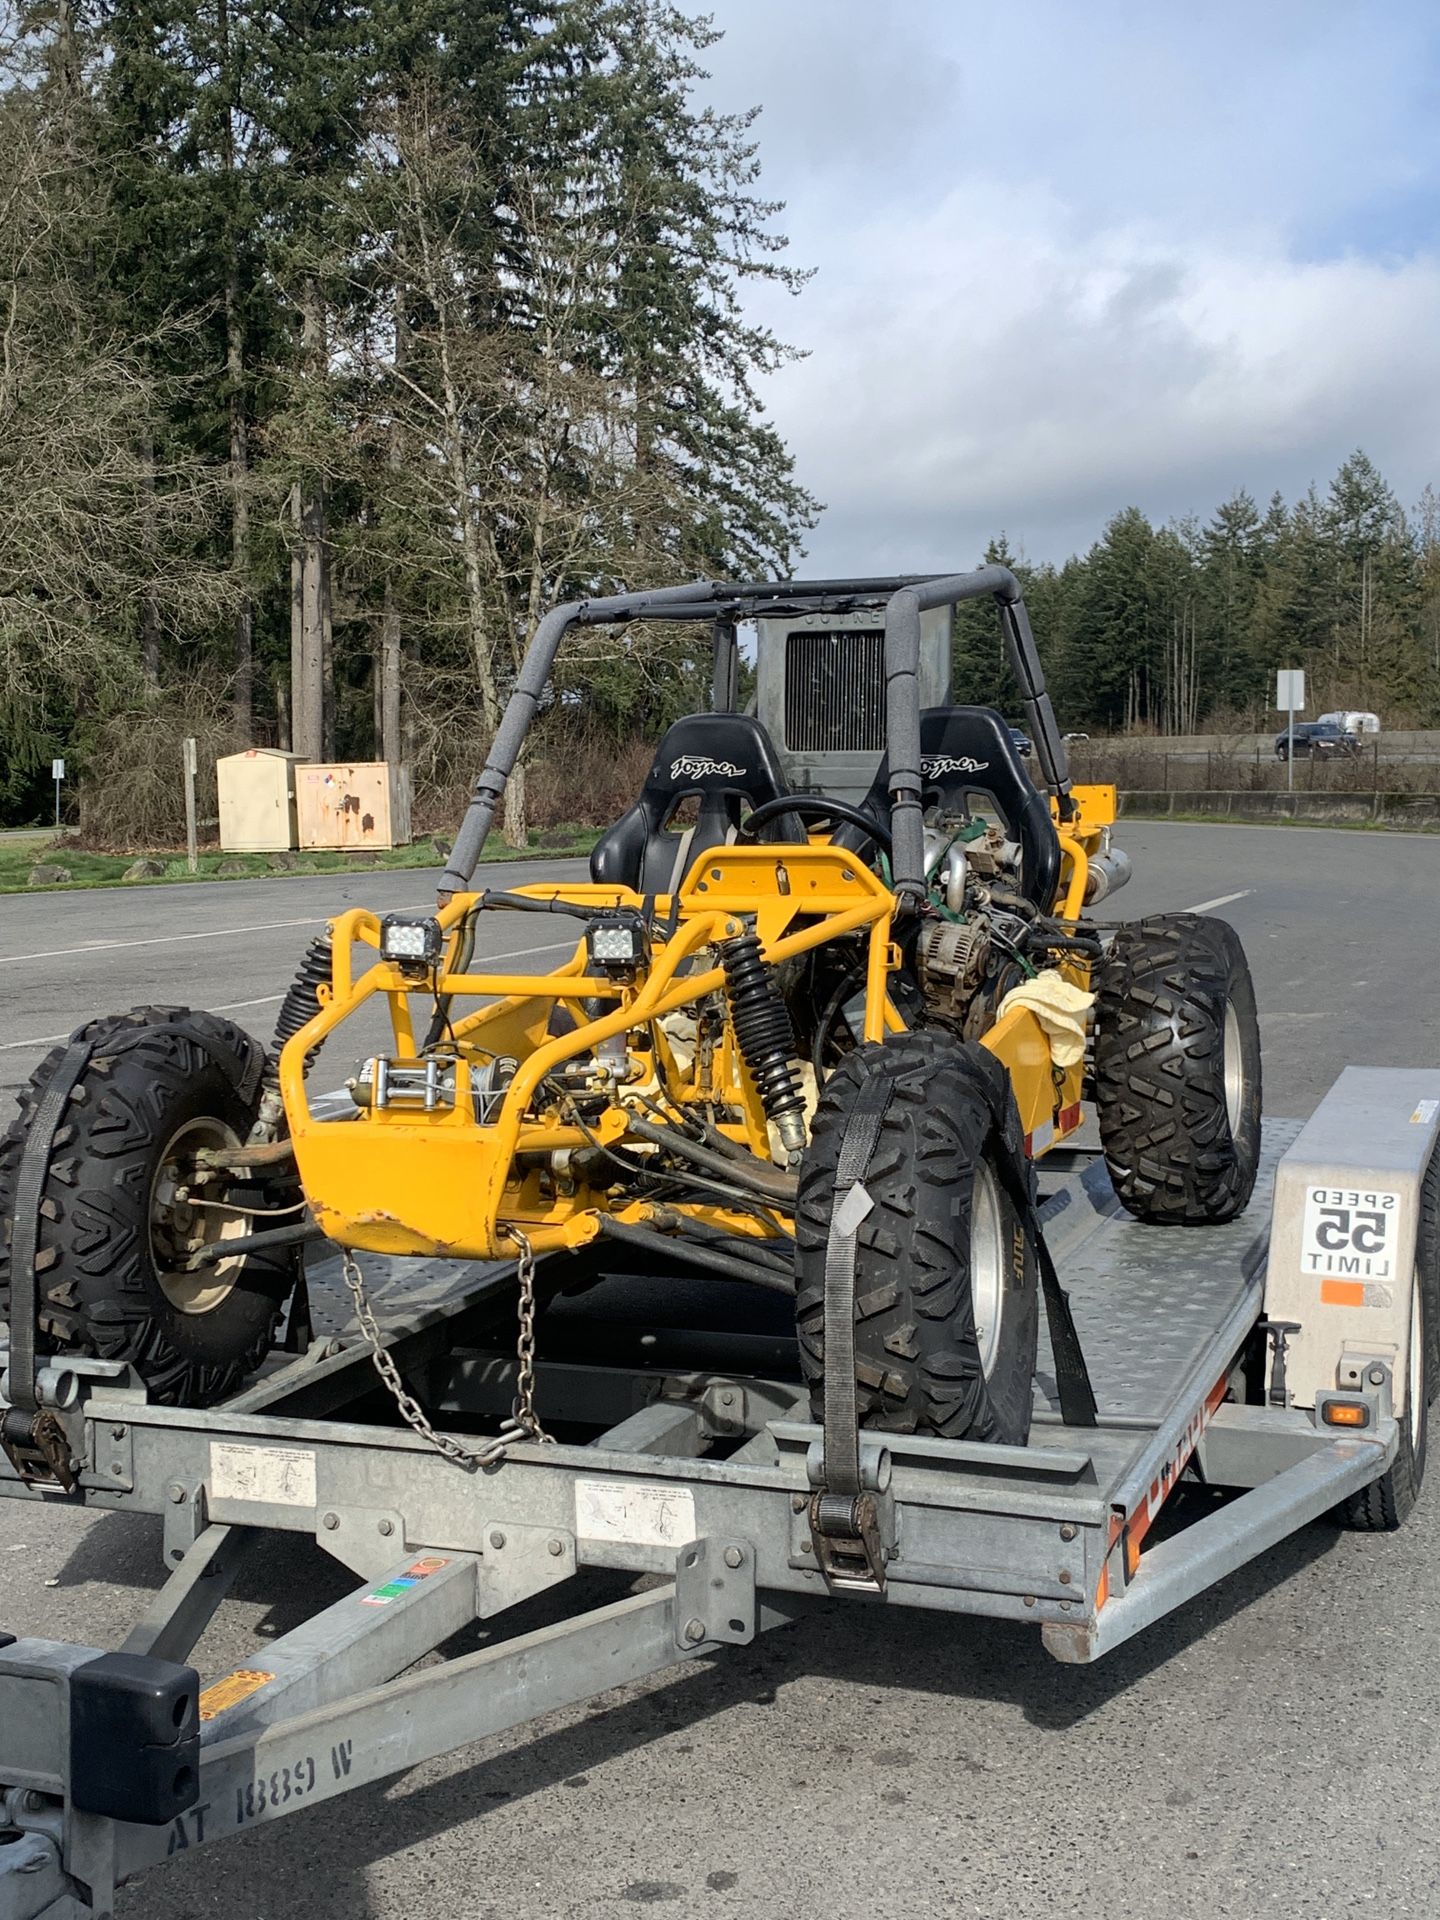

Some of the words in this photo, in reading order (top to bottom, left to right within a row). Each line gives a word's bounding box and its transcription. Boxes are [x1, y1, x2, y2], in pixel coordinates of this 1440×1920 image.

[670, 754, 747, 780] Joyner
[920, 753, 990, 780] oyner
[167, 1802, 211, 1856] AT
[236, 1756, 316, 1824] 1889
